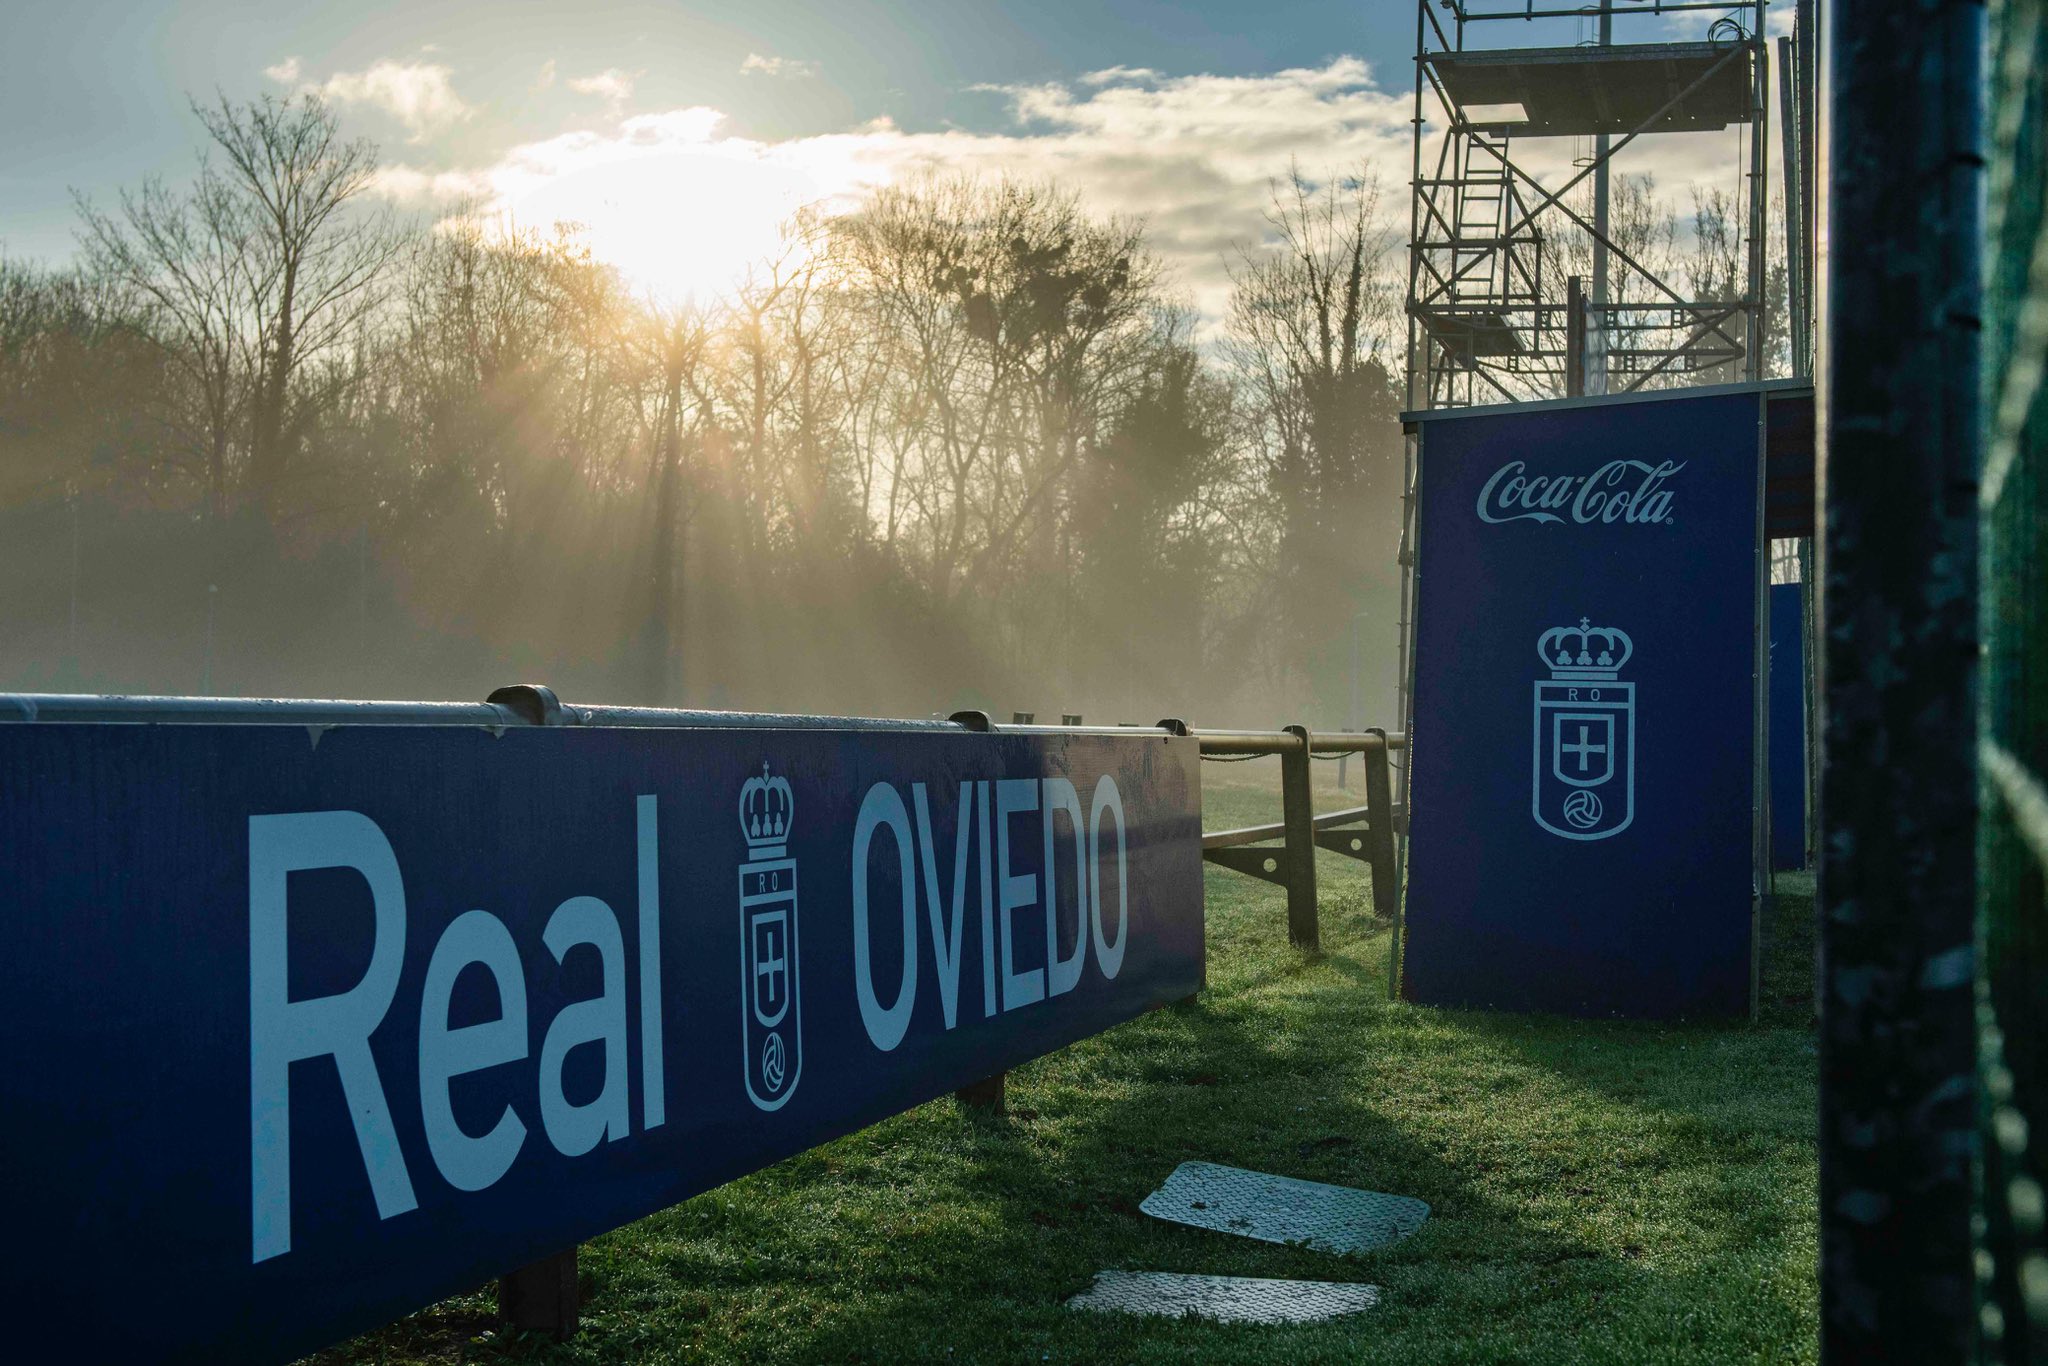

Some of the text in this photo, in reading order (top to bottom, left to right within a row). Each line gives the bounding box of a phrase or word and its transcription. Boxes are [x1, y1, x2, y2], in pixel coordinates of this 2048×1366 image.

[1477, 459, 1688, 525] Coca-Cola
[249, 774, 1128, 1264] Real OVIEDO
